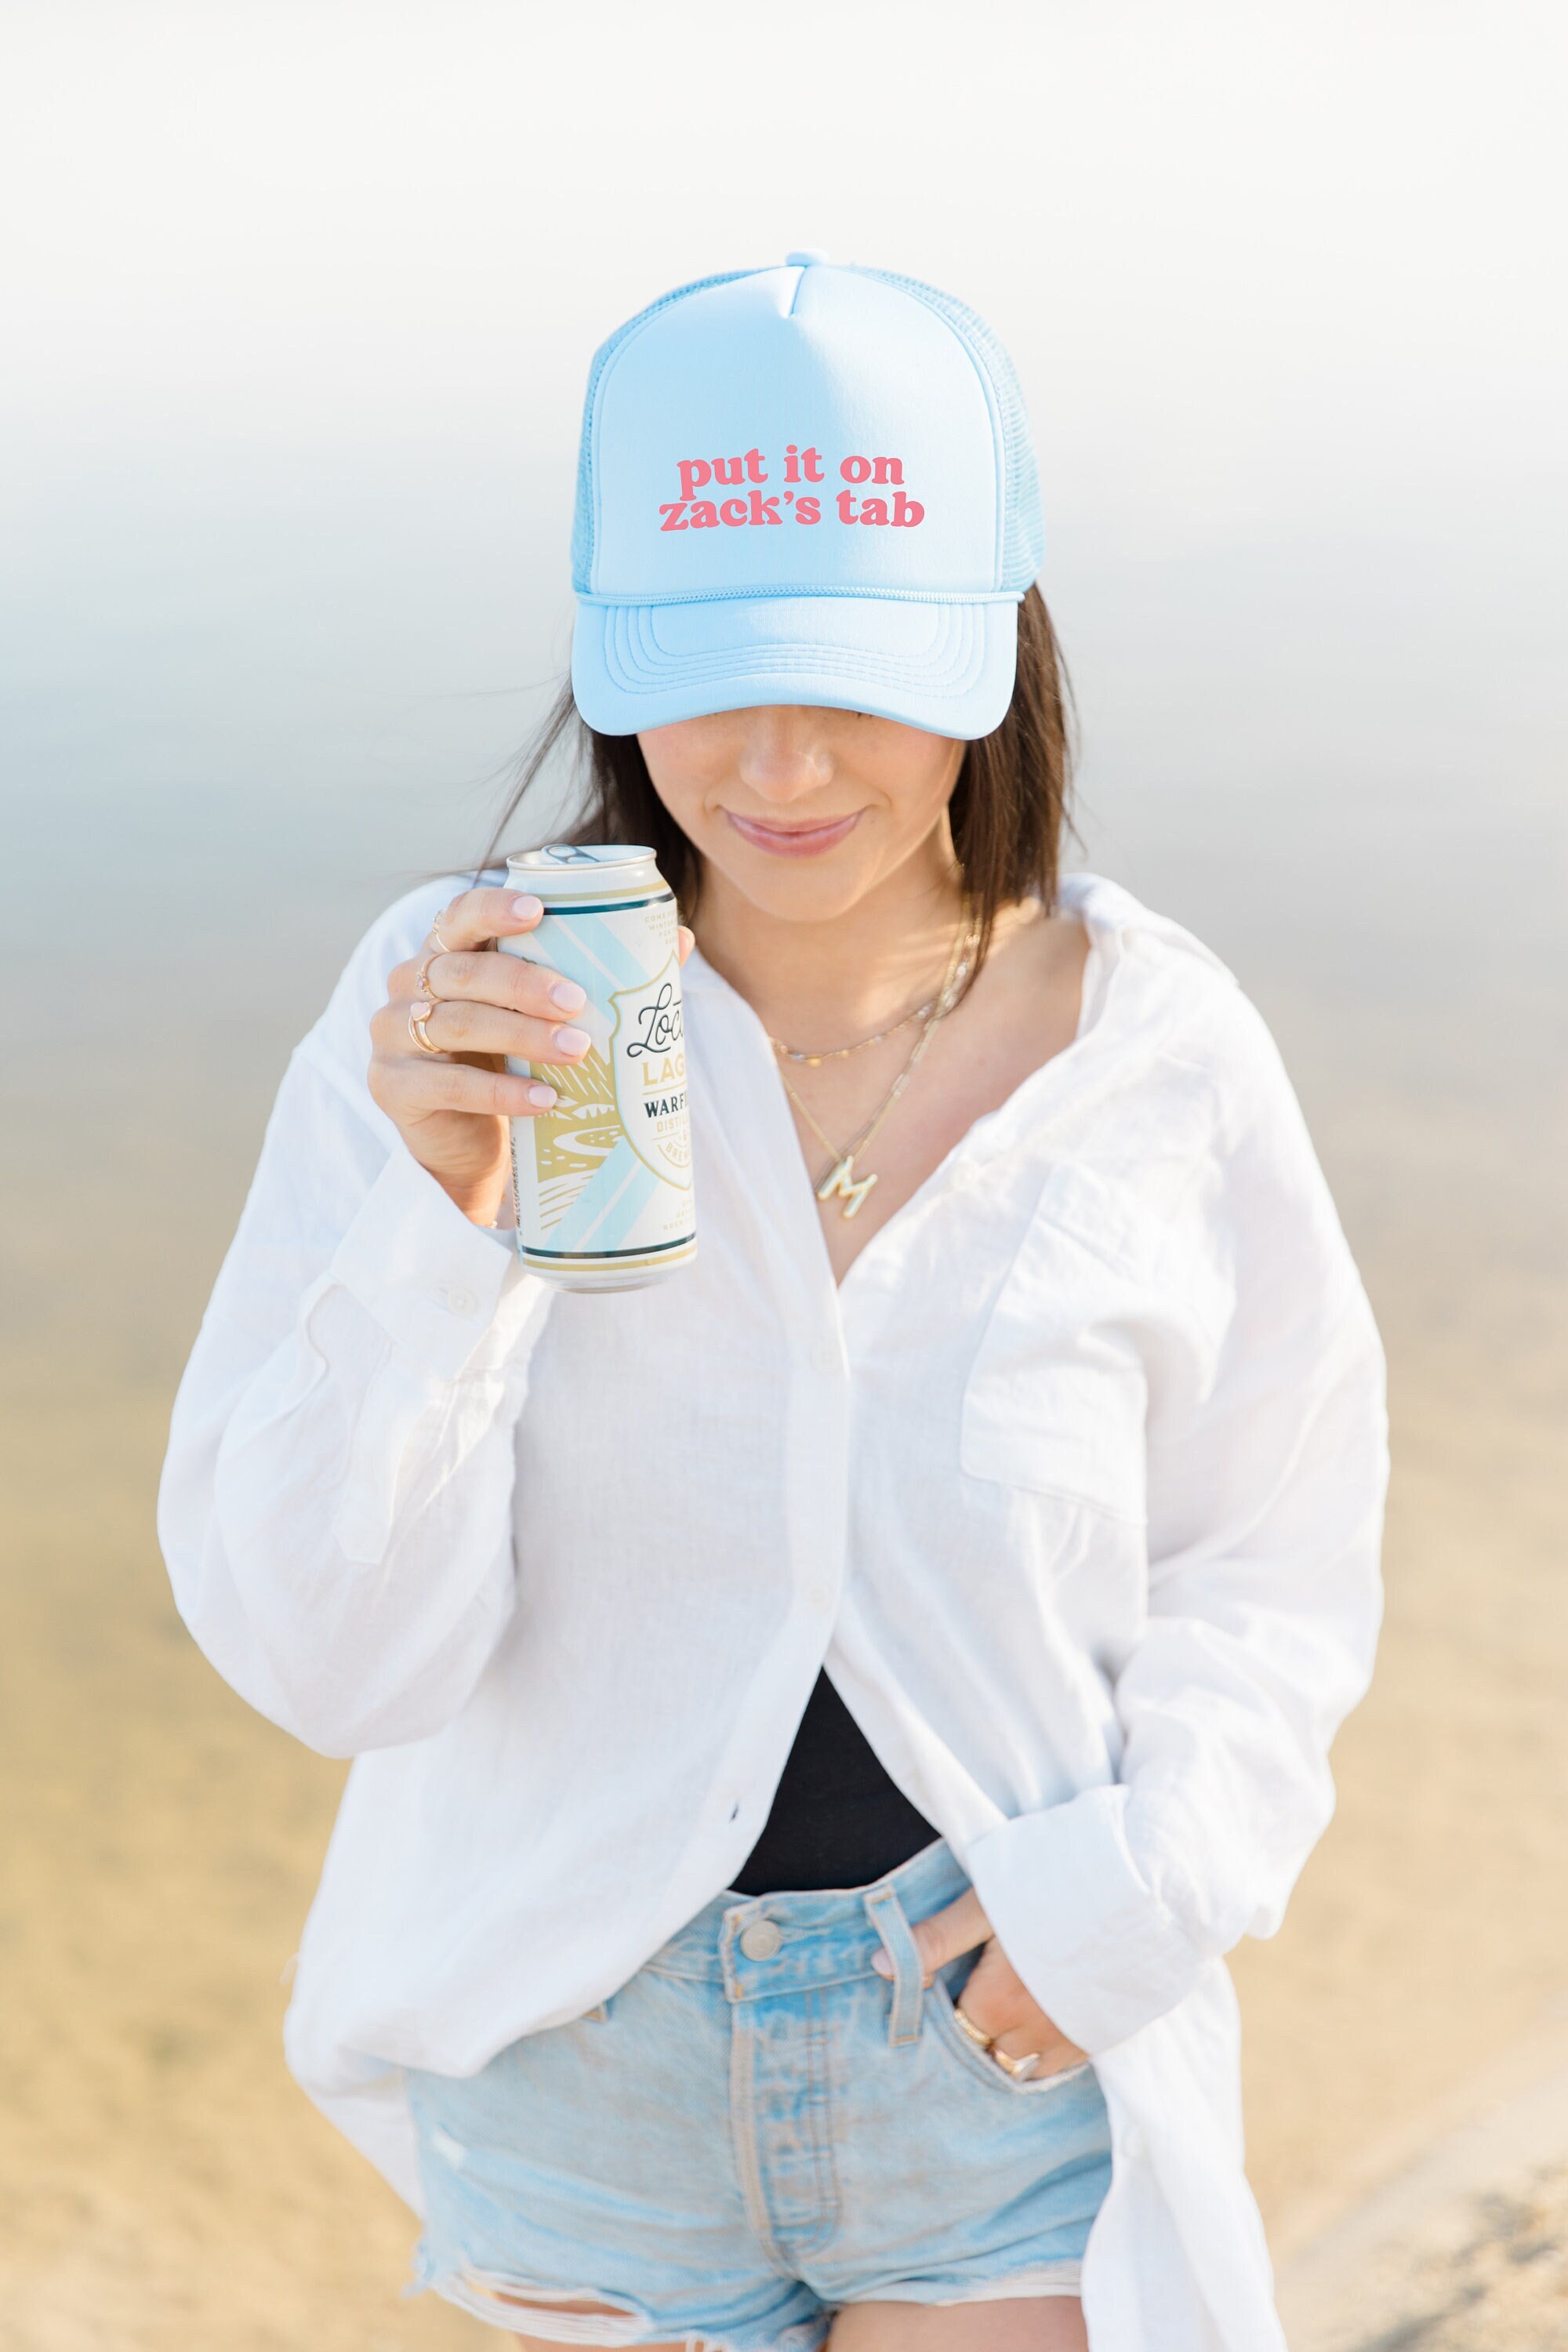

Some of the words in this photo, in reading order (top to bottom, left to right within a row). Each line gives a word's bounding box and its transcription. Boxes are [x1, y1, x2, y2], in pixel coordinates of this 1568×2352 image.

[677, 448, 768, 501] put
[783, 445, 825, 483] it
[840, 456, 905, 485] on
[659, 490, 822, 532] zack's
[836, 489, 925, 528] tab
[817, 1155, 878, 1218] M
